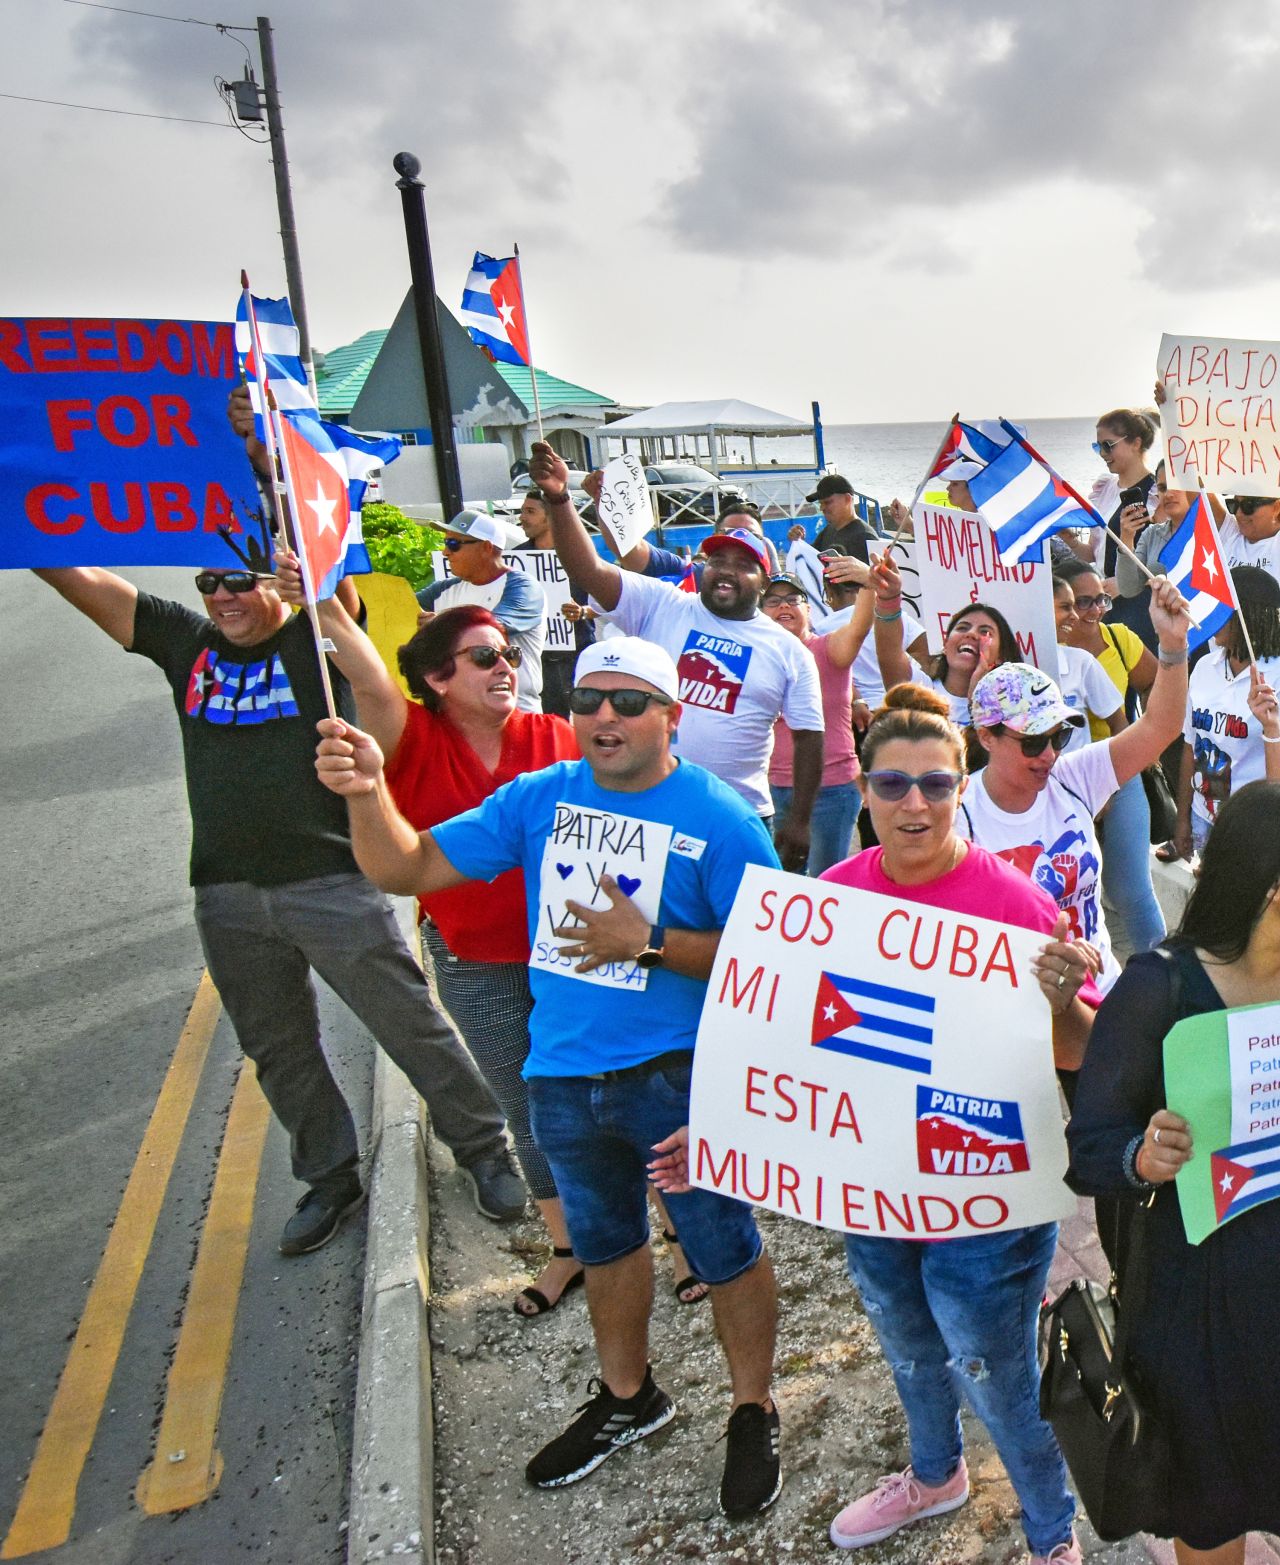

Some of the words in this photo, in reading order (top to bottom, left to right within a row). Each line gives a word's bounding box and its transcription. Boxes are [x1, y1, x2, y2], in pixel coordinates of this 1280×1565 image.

[1164, 345, 1278, 390] ABAJO
[46, 394, 200, 452] FOR
[1167, 435, 1267, 478] PATRIA
[24, 481, 244, 535] CUBA
[526, 552, 567, 583] THE
[695, 634, 744, 658] PATRIA
[678, 677, 730, 711] VIDA
[705, 668, 715, 680] Y
[1214, 711, 1227, 734] Y
[551, 805, 645, 863] PATRIA
[586, 861, 607, 905] Y
[754, 889, 840, 947] SOS
[876, 908, 1019, 989] CUBA
[717, 956, 781, 1023] MI
[744, 1065, 863, 1145] ESTA
[930, 1090, 1003, 1119] PATRIA
[930, 1148, 1014, 1175] VIDA
[961, 1135, 973, 1148] Y
[696, 1137, 1010, 1233] MURIENDO
